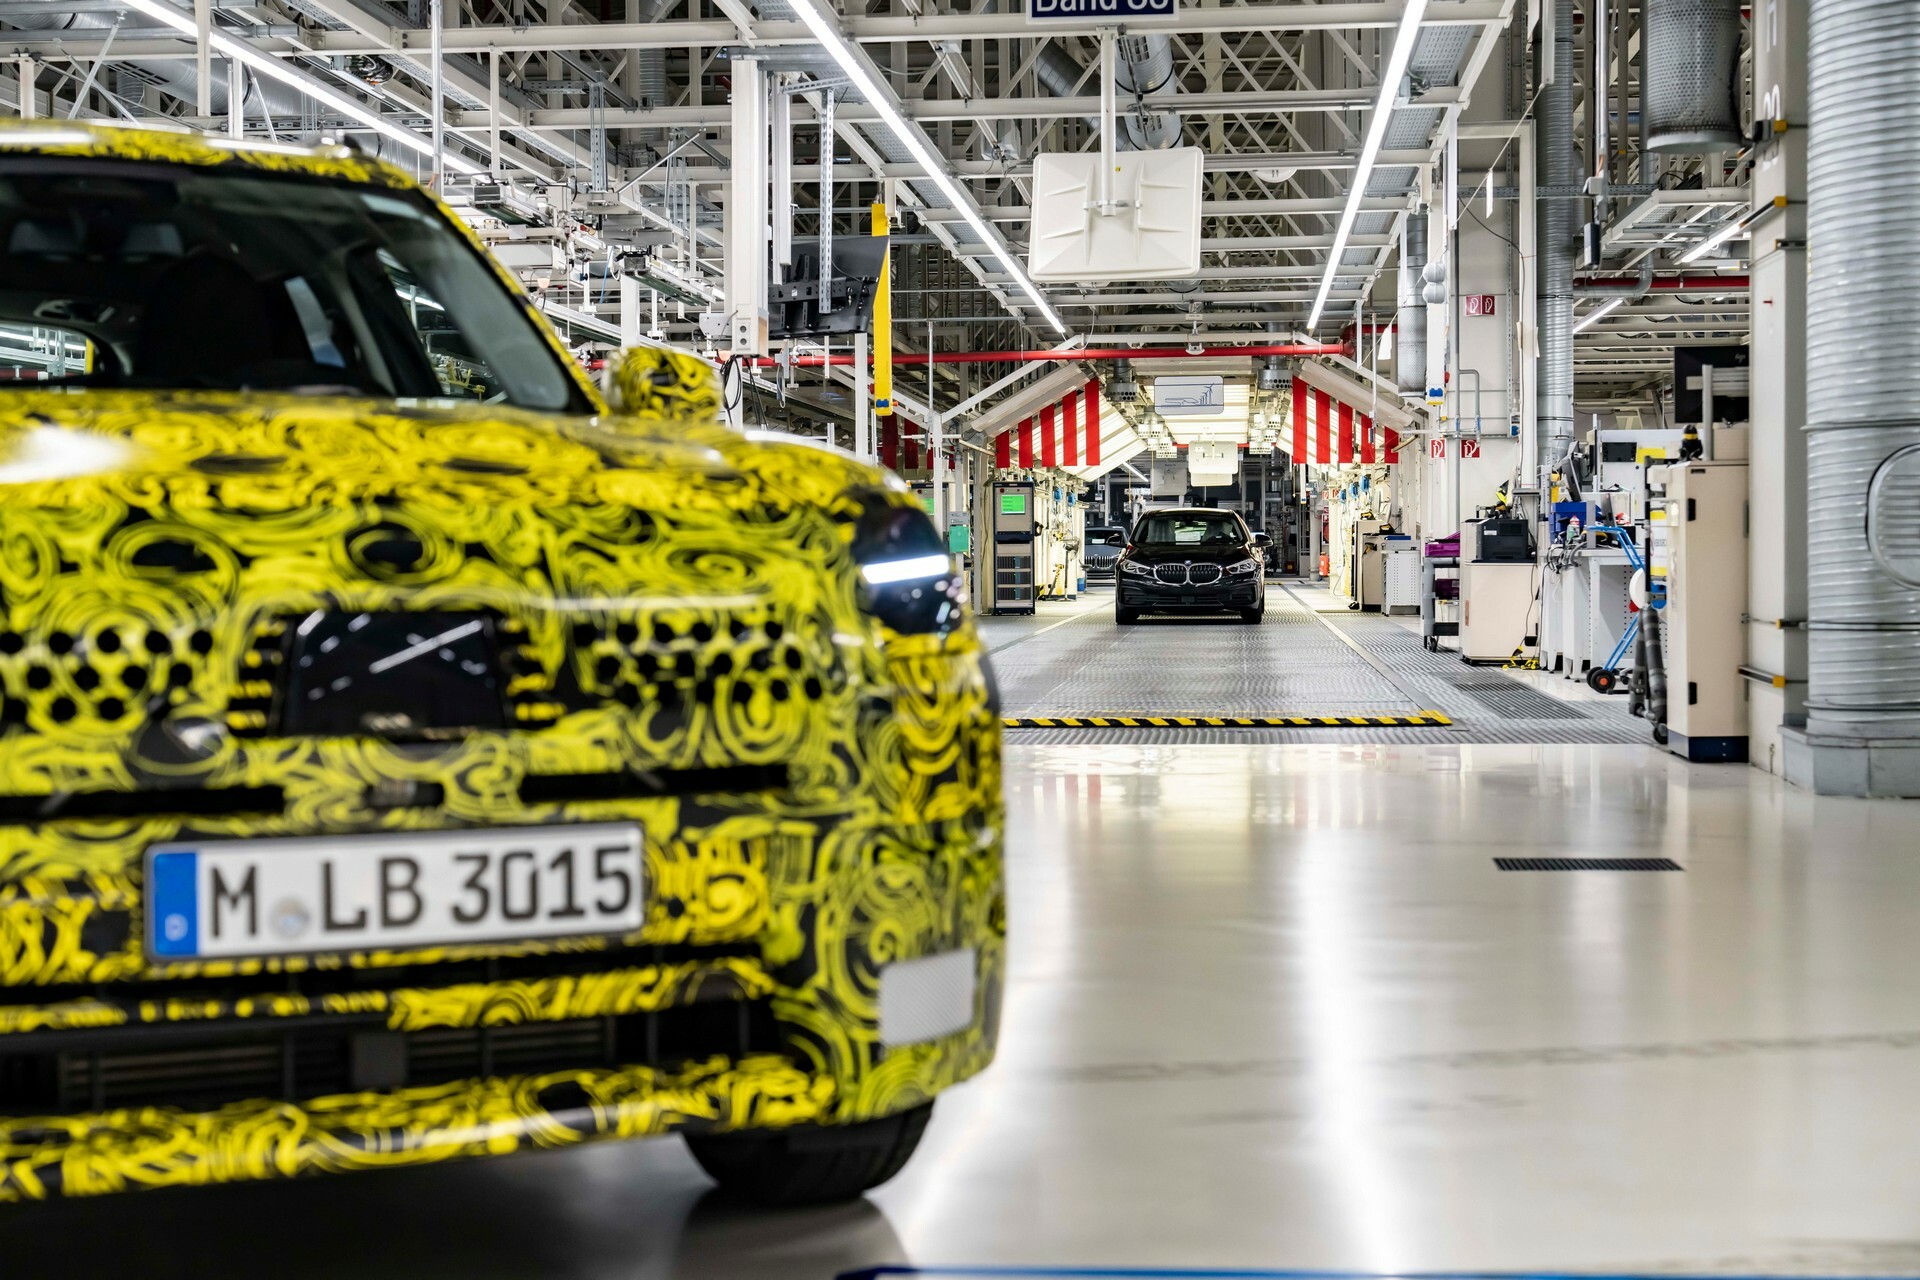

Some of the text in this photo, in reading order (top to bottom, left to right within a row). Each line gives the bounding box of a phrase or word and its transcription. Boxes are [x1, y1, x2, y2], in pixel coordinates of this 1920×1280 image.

[210, 845, 632, 939] M LB 3015
